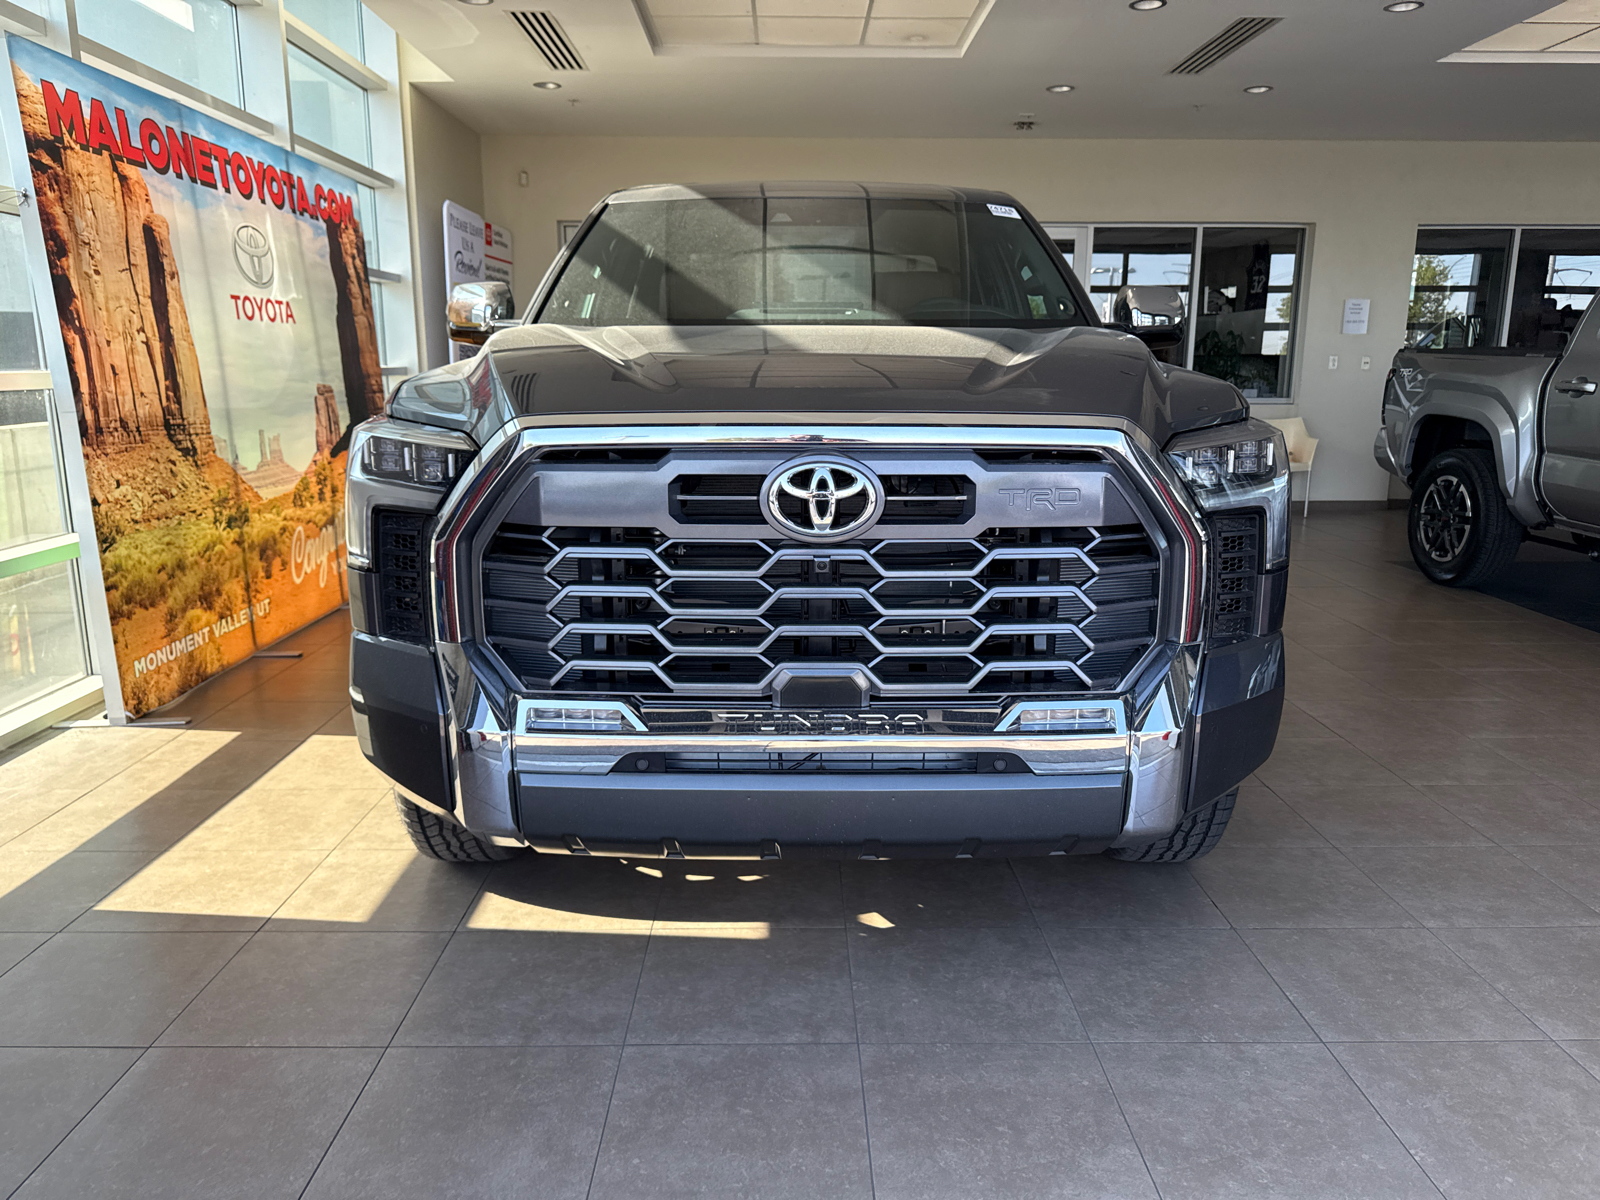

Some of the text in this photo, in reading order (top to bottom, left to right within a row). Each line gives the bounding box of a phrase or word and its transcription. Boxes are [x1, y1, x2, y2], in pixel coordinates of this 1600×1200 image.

[40, 79, 357, 228] MALONETOYOTA.COM
[1250, 275, 1266, 294] 32
[230, 293, 297, 325] TOYOTA
[998, 487, 1081, 511] TRD
[133, 626, 211, 678] MONUMENT
[256, 598, 271, 617] UT
